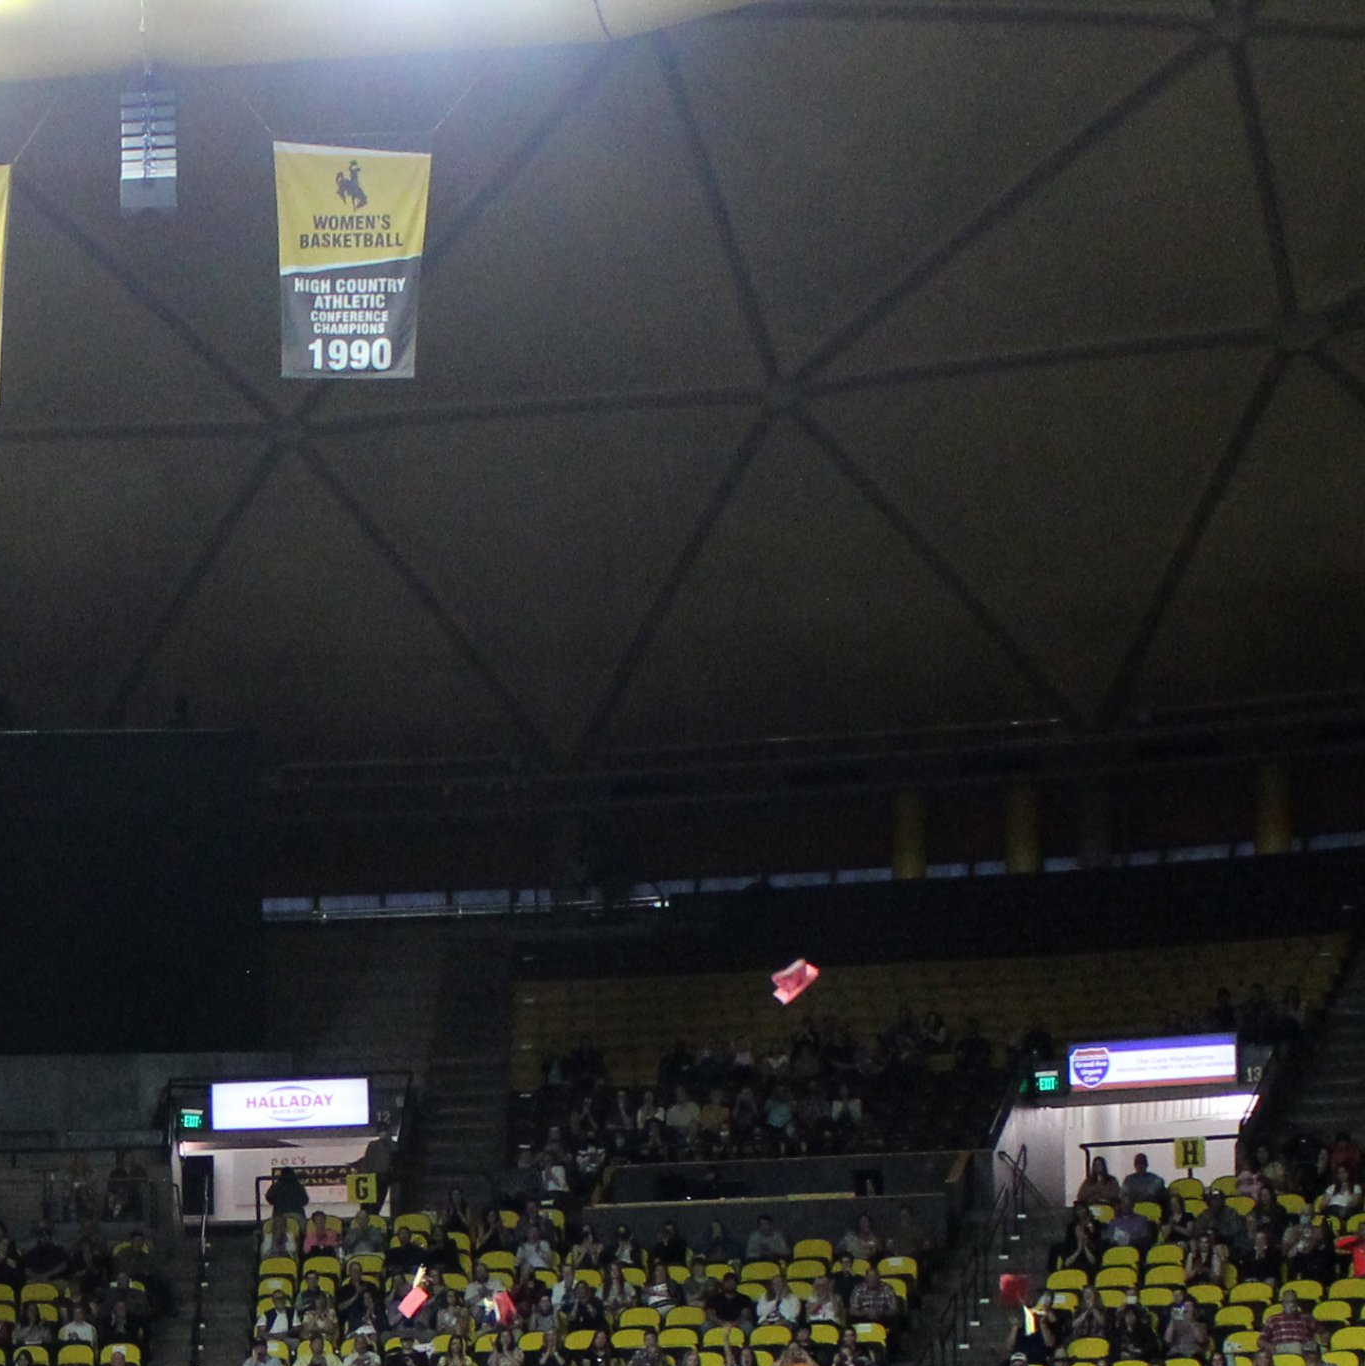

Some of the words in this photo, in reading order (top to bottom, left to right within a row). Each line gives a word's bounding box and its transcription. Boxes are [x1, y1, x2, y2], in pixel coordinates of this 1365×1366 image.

[313, 215, 390, 230] WOMEN'S
[300, 233, 403, 249] BASKETBALL
[294, 277, 331, 293] HIGH
[335, 277, 406, 293] COUNTRY
[314, 294, 386, 309] ATHLETIC
[310, 310, 389, 322] CONFERENCE
[313, 322, 385, 335] CHAMPIONS
[308, 338, 392, 370] 1990
[1246, 1066, 1262, 1082] 13
[1039, 1077, 1055, 1090] EXIT
[246, 1094, 334, 1109] HALLADAY
[184, 1115, 199, 1127] EXIT
[1182, 1140, 1199, 1165] H
[356, 1177, 368, 1200] G
